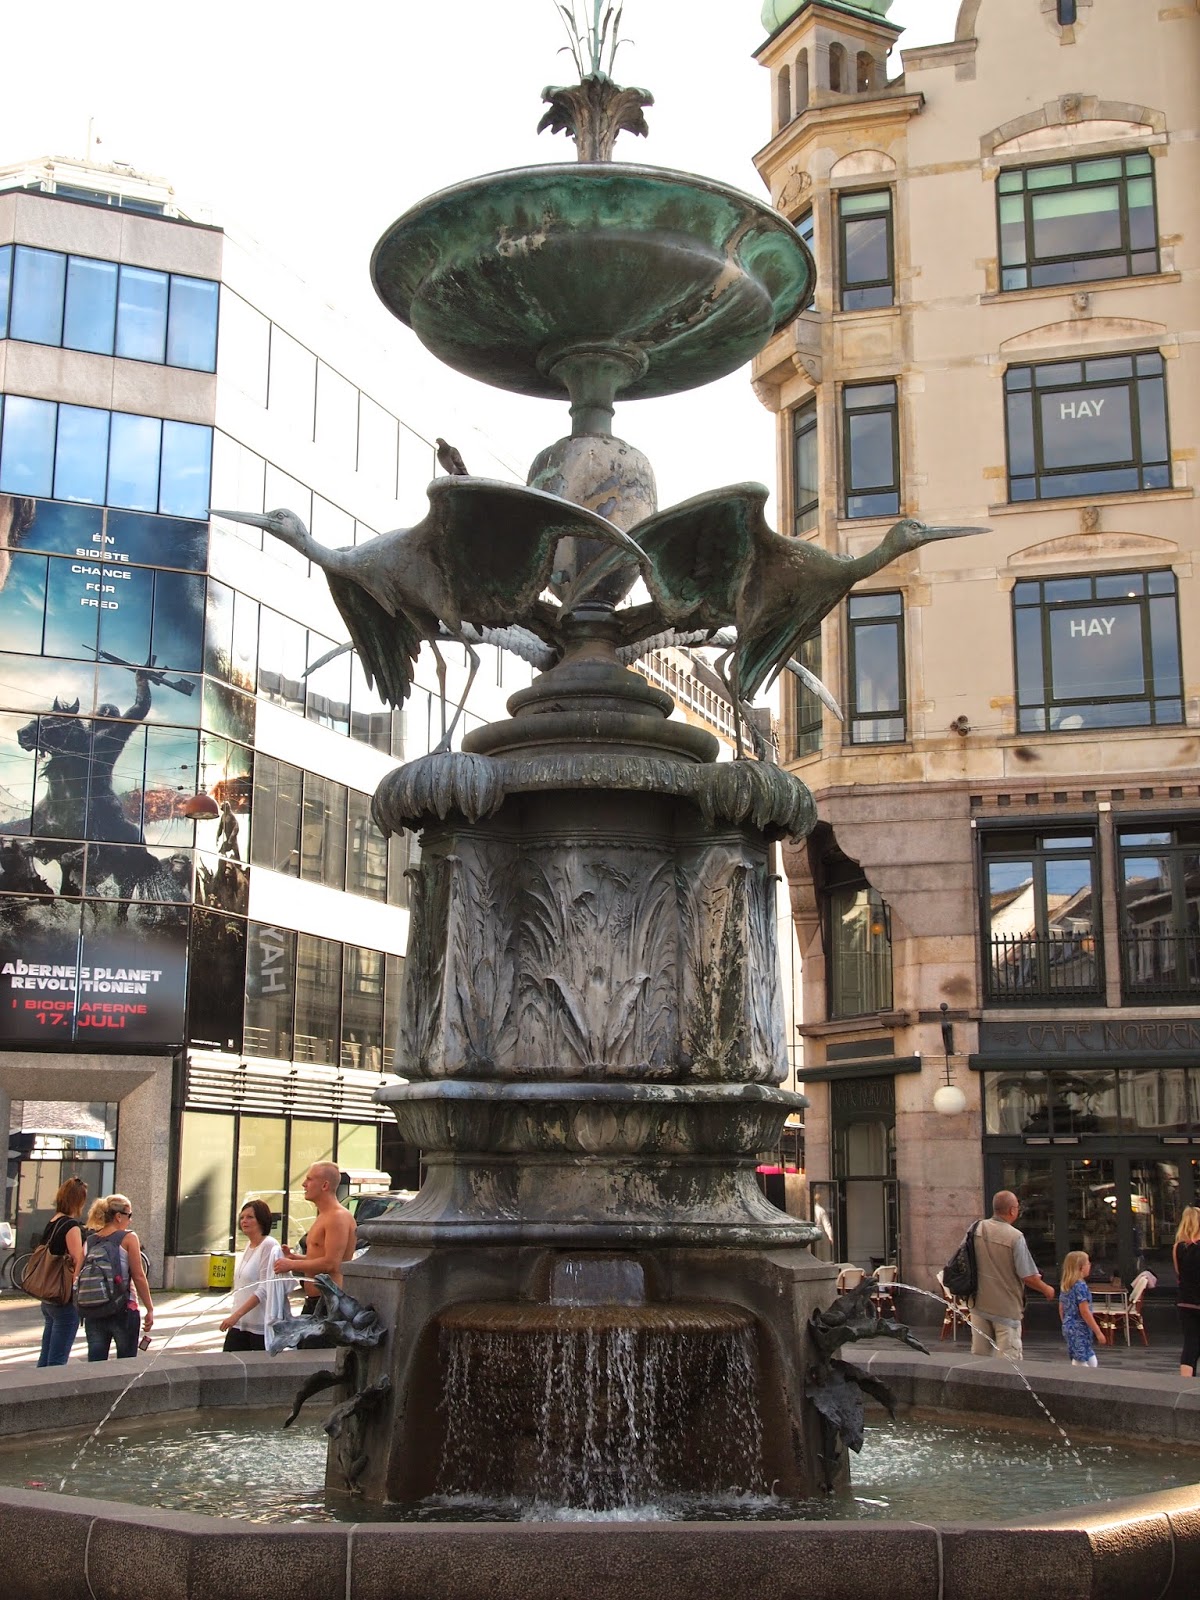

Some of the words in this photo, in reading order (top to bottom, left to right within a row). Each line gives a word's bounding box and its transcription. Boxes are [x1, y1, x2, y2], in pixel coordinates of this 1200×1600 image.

[1060, 399, 1105, 420] HAY
[92, 532, 115, 545] ÉN
[76, 548, 130, 562] SIDSTE
[71, 565, 132, 580] CHANCE
[85, 582, 116, 594] FOR
[80, 598, 119, 610] FRED
[1070, 617, 1116, 638] HAY
[93, 967, 162, 982] PLANET
[11, 976, 147, 994] REVOLUTIONEN
[12, 999, 17, 1009] I
[24, 1000, 148, 1014] BIOGRAFERNE
[35, 1012, 69, 1026] 17.
[77, 1014, 126, 1028] JULI
